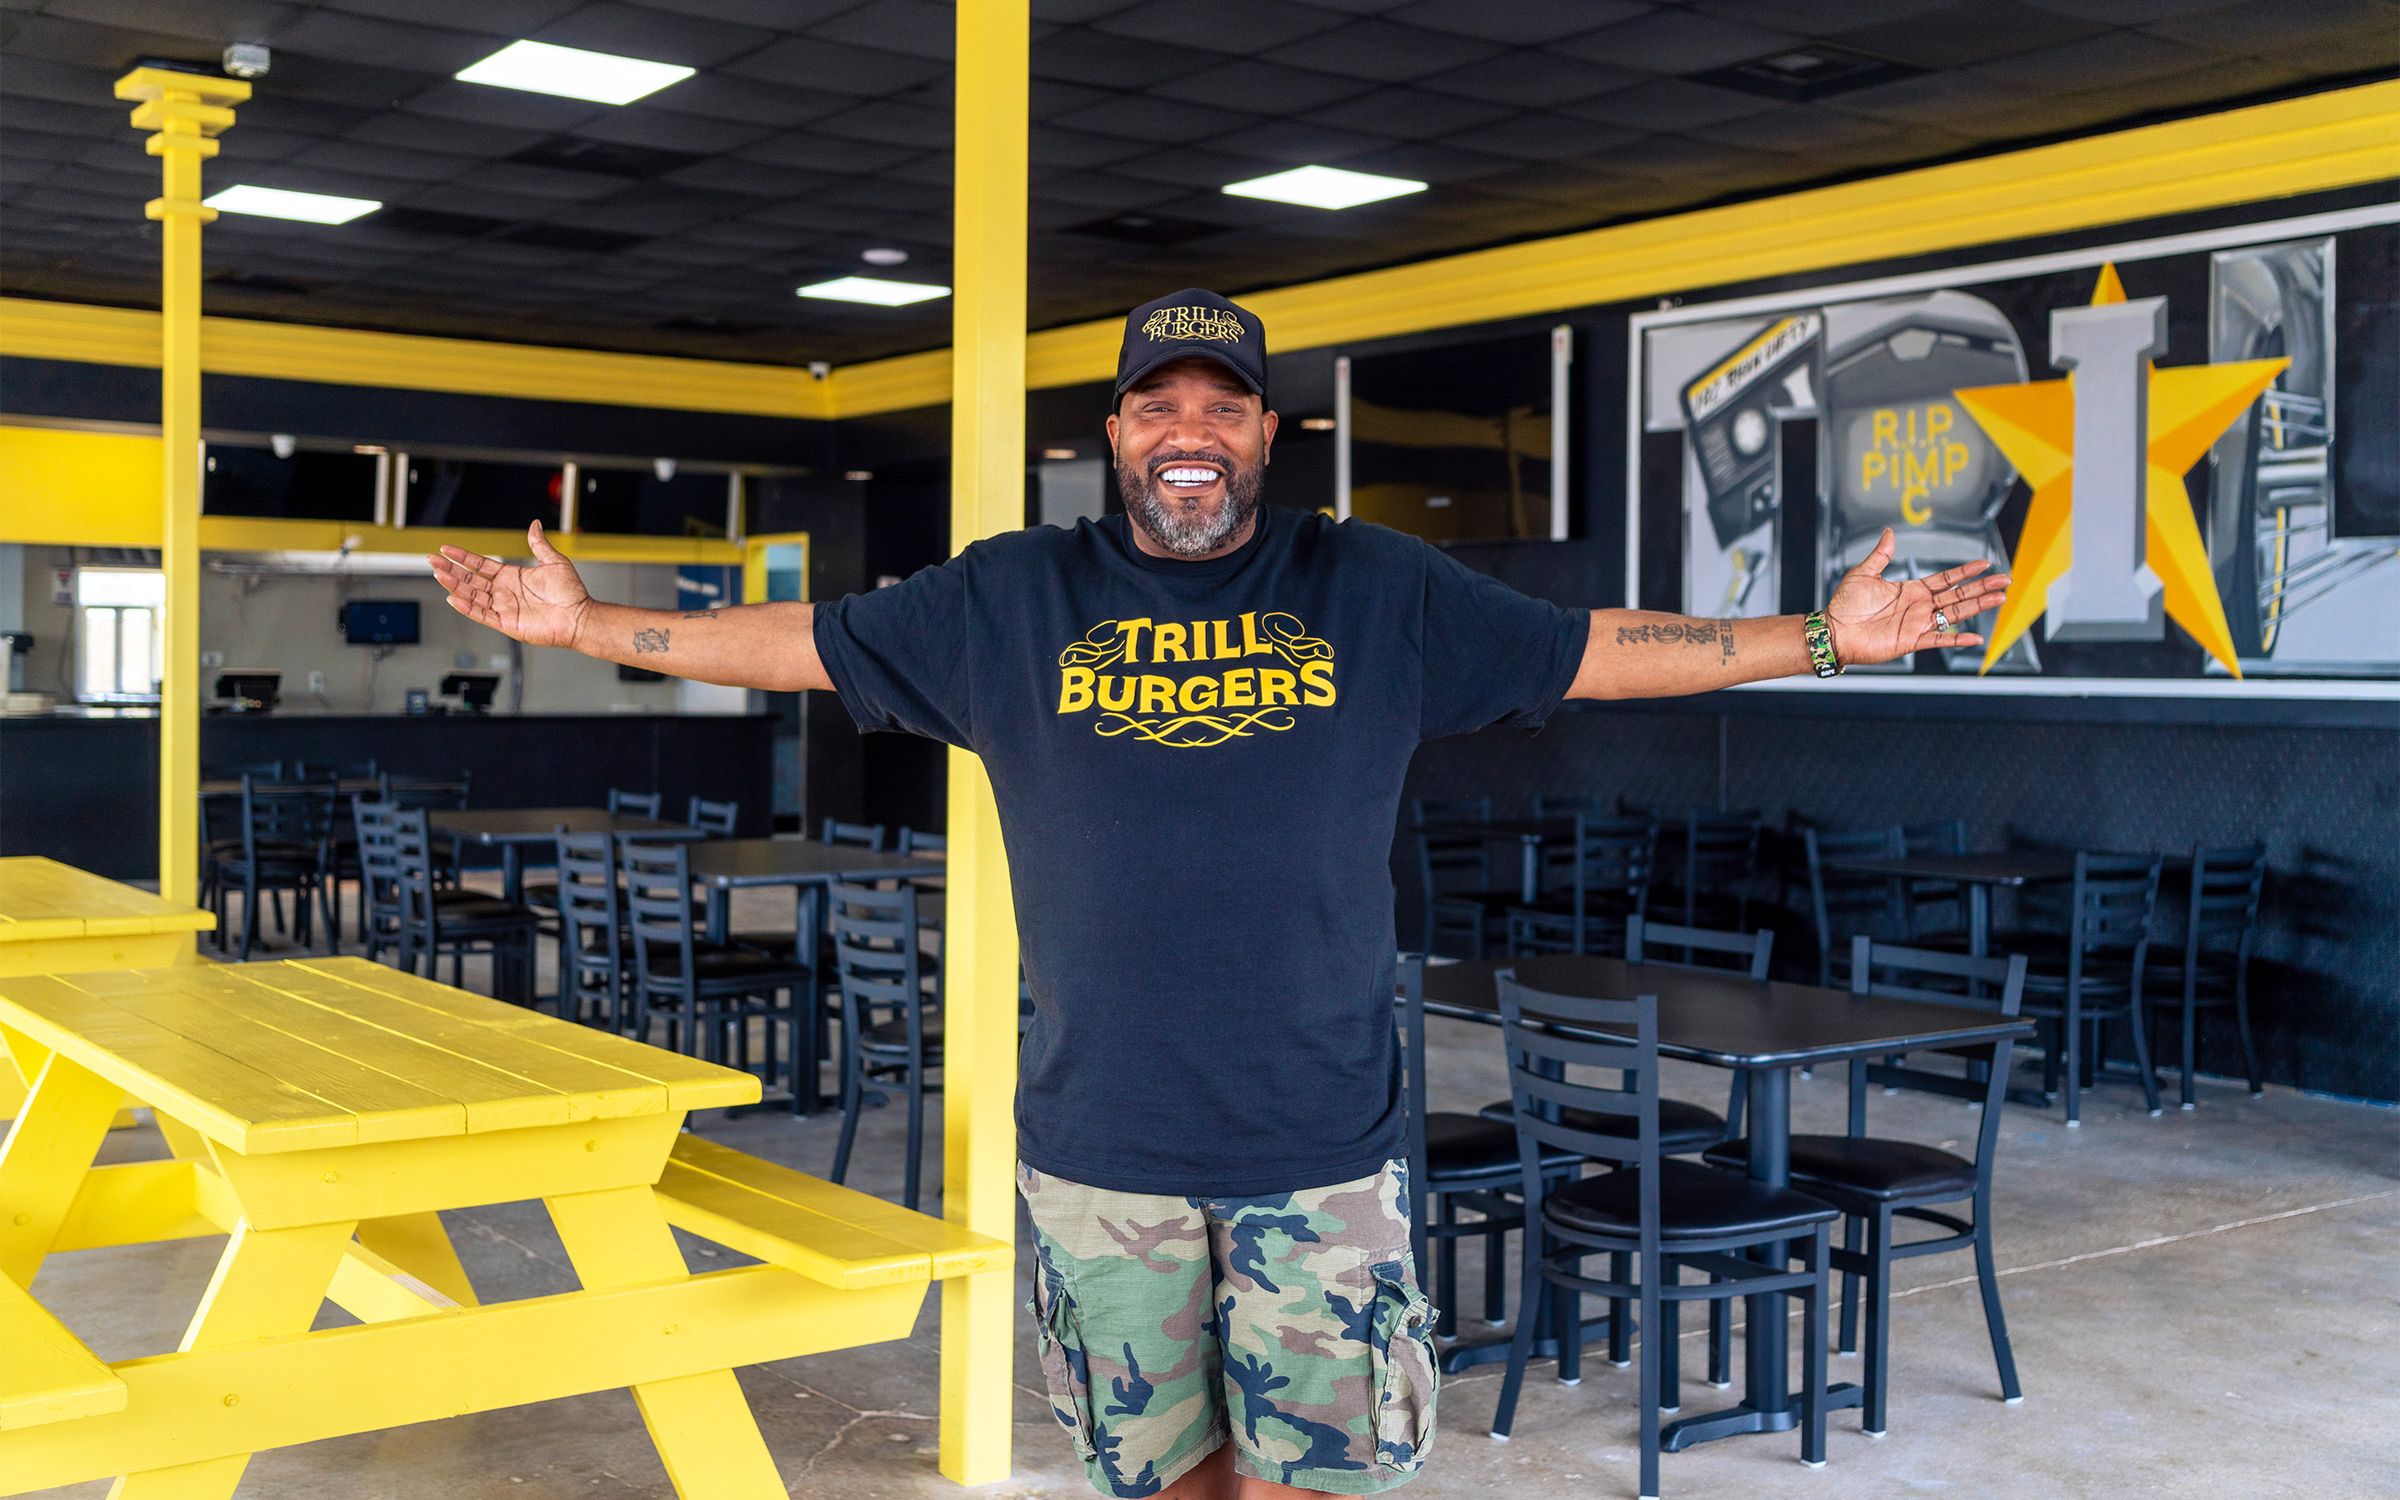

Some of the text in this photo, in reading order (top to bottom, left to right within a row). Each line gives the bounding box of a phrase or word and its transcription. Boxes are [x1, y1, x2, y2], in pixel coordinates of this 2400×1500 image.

[1149, 320, 1239, 343] BURGERS
[1162, 306, 1226, 325] TRILL
[1862, 442, 1969, 491] PIMP
[1902, 485, 1932, 526] C
[1116, 611, 1273, 664] TRILL
[1057, 660, 1337, 714] BURGERS
